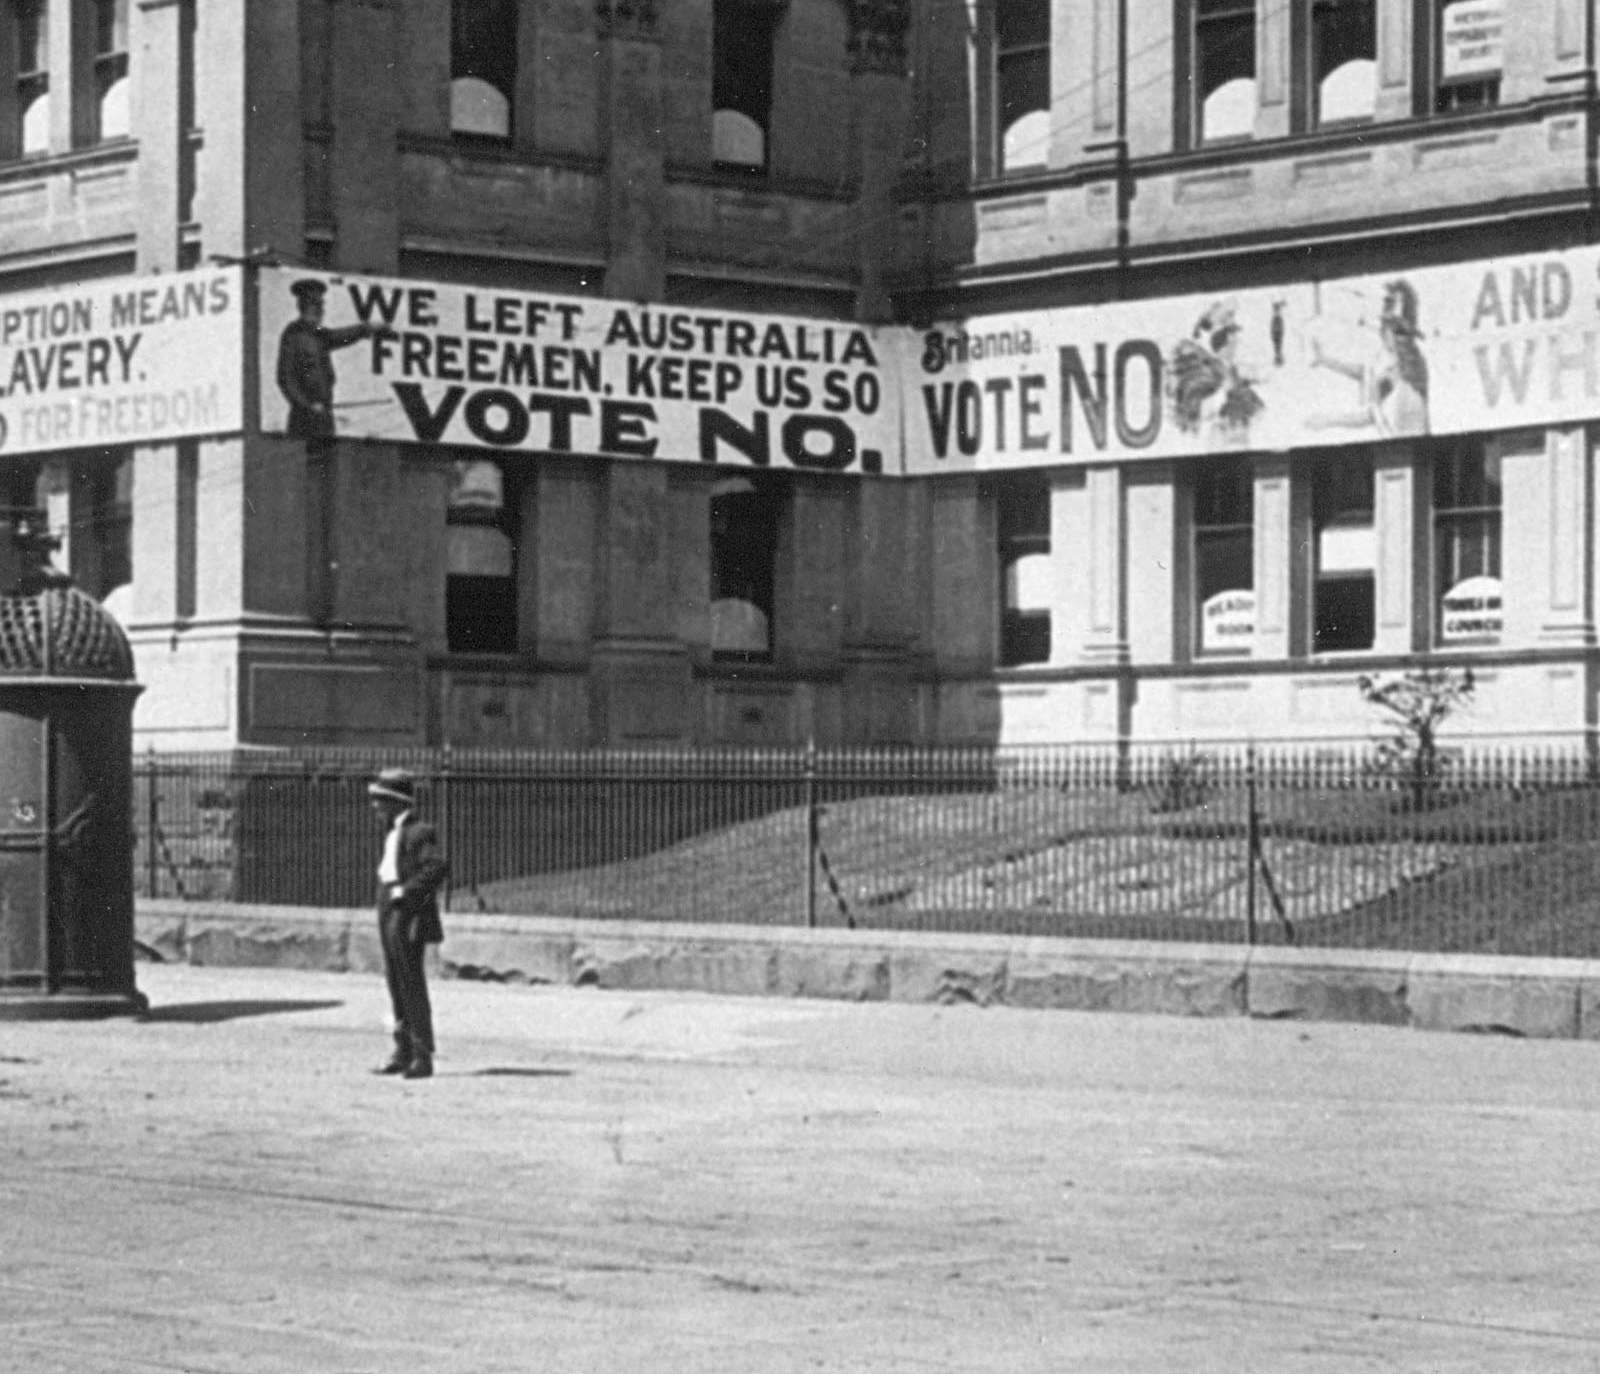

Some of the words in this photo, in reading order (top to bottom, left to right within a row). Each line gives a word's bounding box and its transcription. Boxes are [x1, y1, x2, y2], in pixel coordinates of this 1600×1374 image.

[110, 276, 231, 329] MEANS
[1471, 262, 1572, 330] AND
[465, 293, 583, 340] LEFT
[606, 306, 879, 368] AUSTRALIA
[19, 404, 74, 444] FOR
[77, 385, 220, 441] FREEDOM
[626, 352, 743, 404] KEEP
[756, 364, 812, 411] US
[822, 371, 880, 417] SO
[921, 373, 1050, 461] VOTE
[1058, 337, 1163, 455] NO
[392, 382, 660, 459] VOTE
[699, 406, 883, 473] NO.
